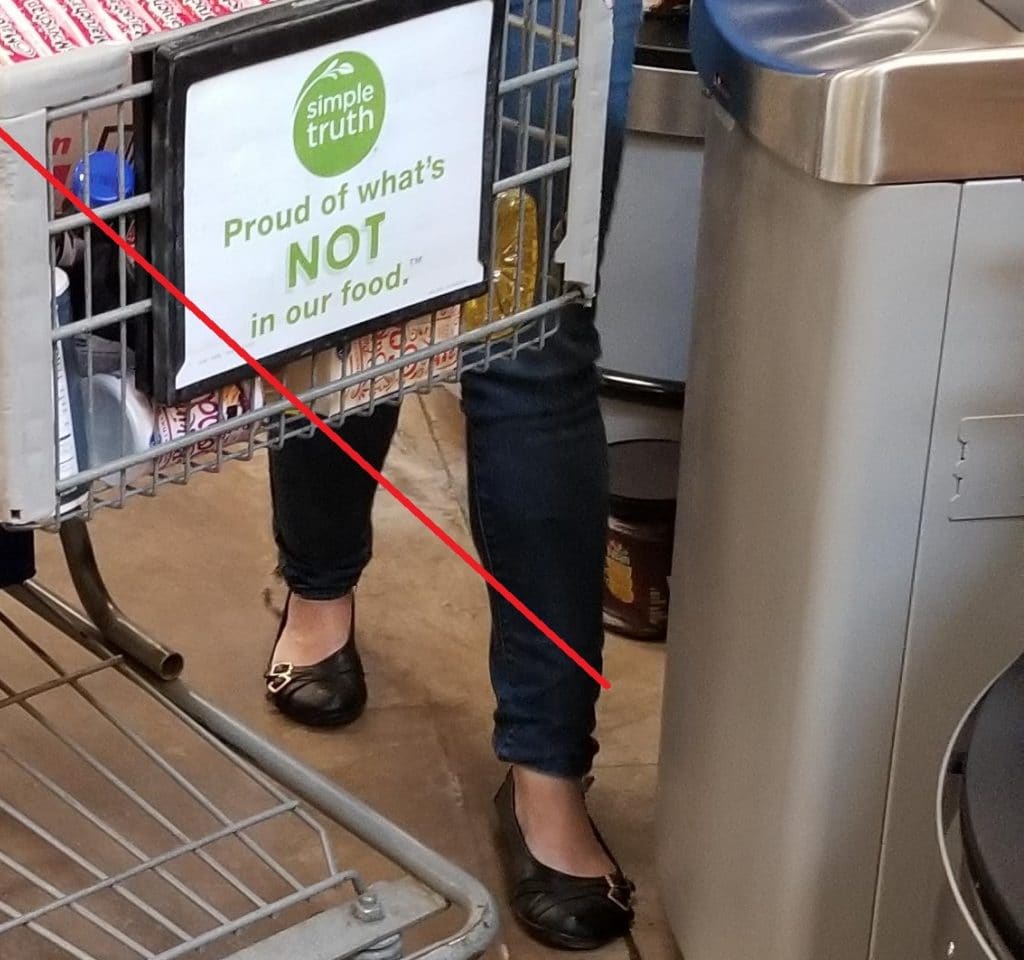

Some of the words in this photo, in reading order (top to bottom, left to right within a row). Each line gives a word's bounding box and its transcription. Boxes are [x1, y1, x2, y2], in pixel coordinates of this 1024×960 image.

[307, 82, 375, 119] simple
[307, 106, 375, 148] truth
[224, 195, 311, 248] Proud
[321, 183, 349, 217] of
[357, 156, 445, 204] what's
[288, 212, 387, 288] NOT
[250, 312, 275, 339] in
[286, 293, 333, 326] our
